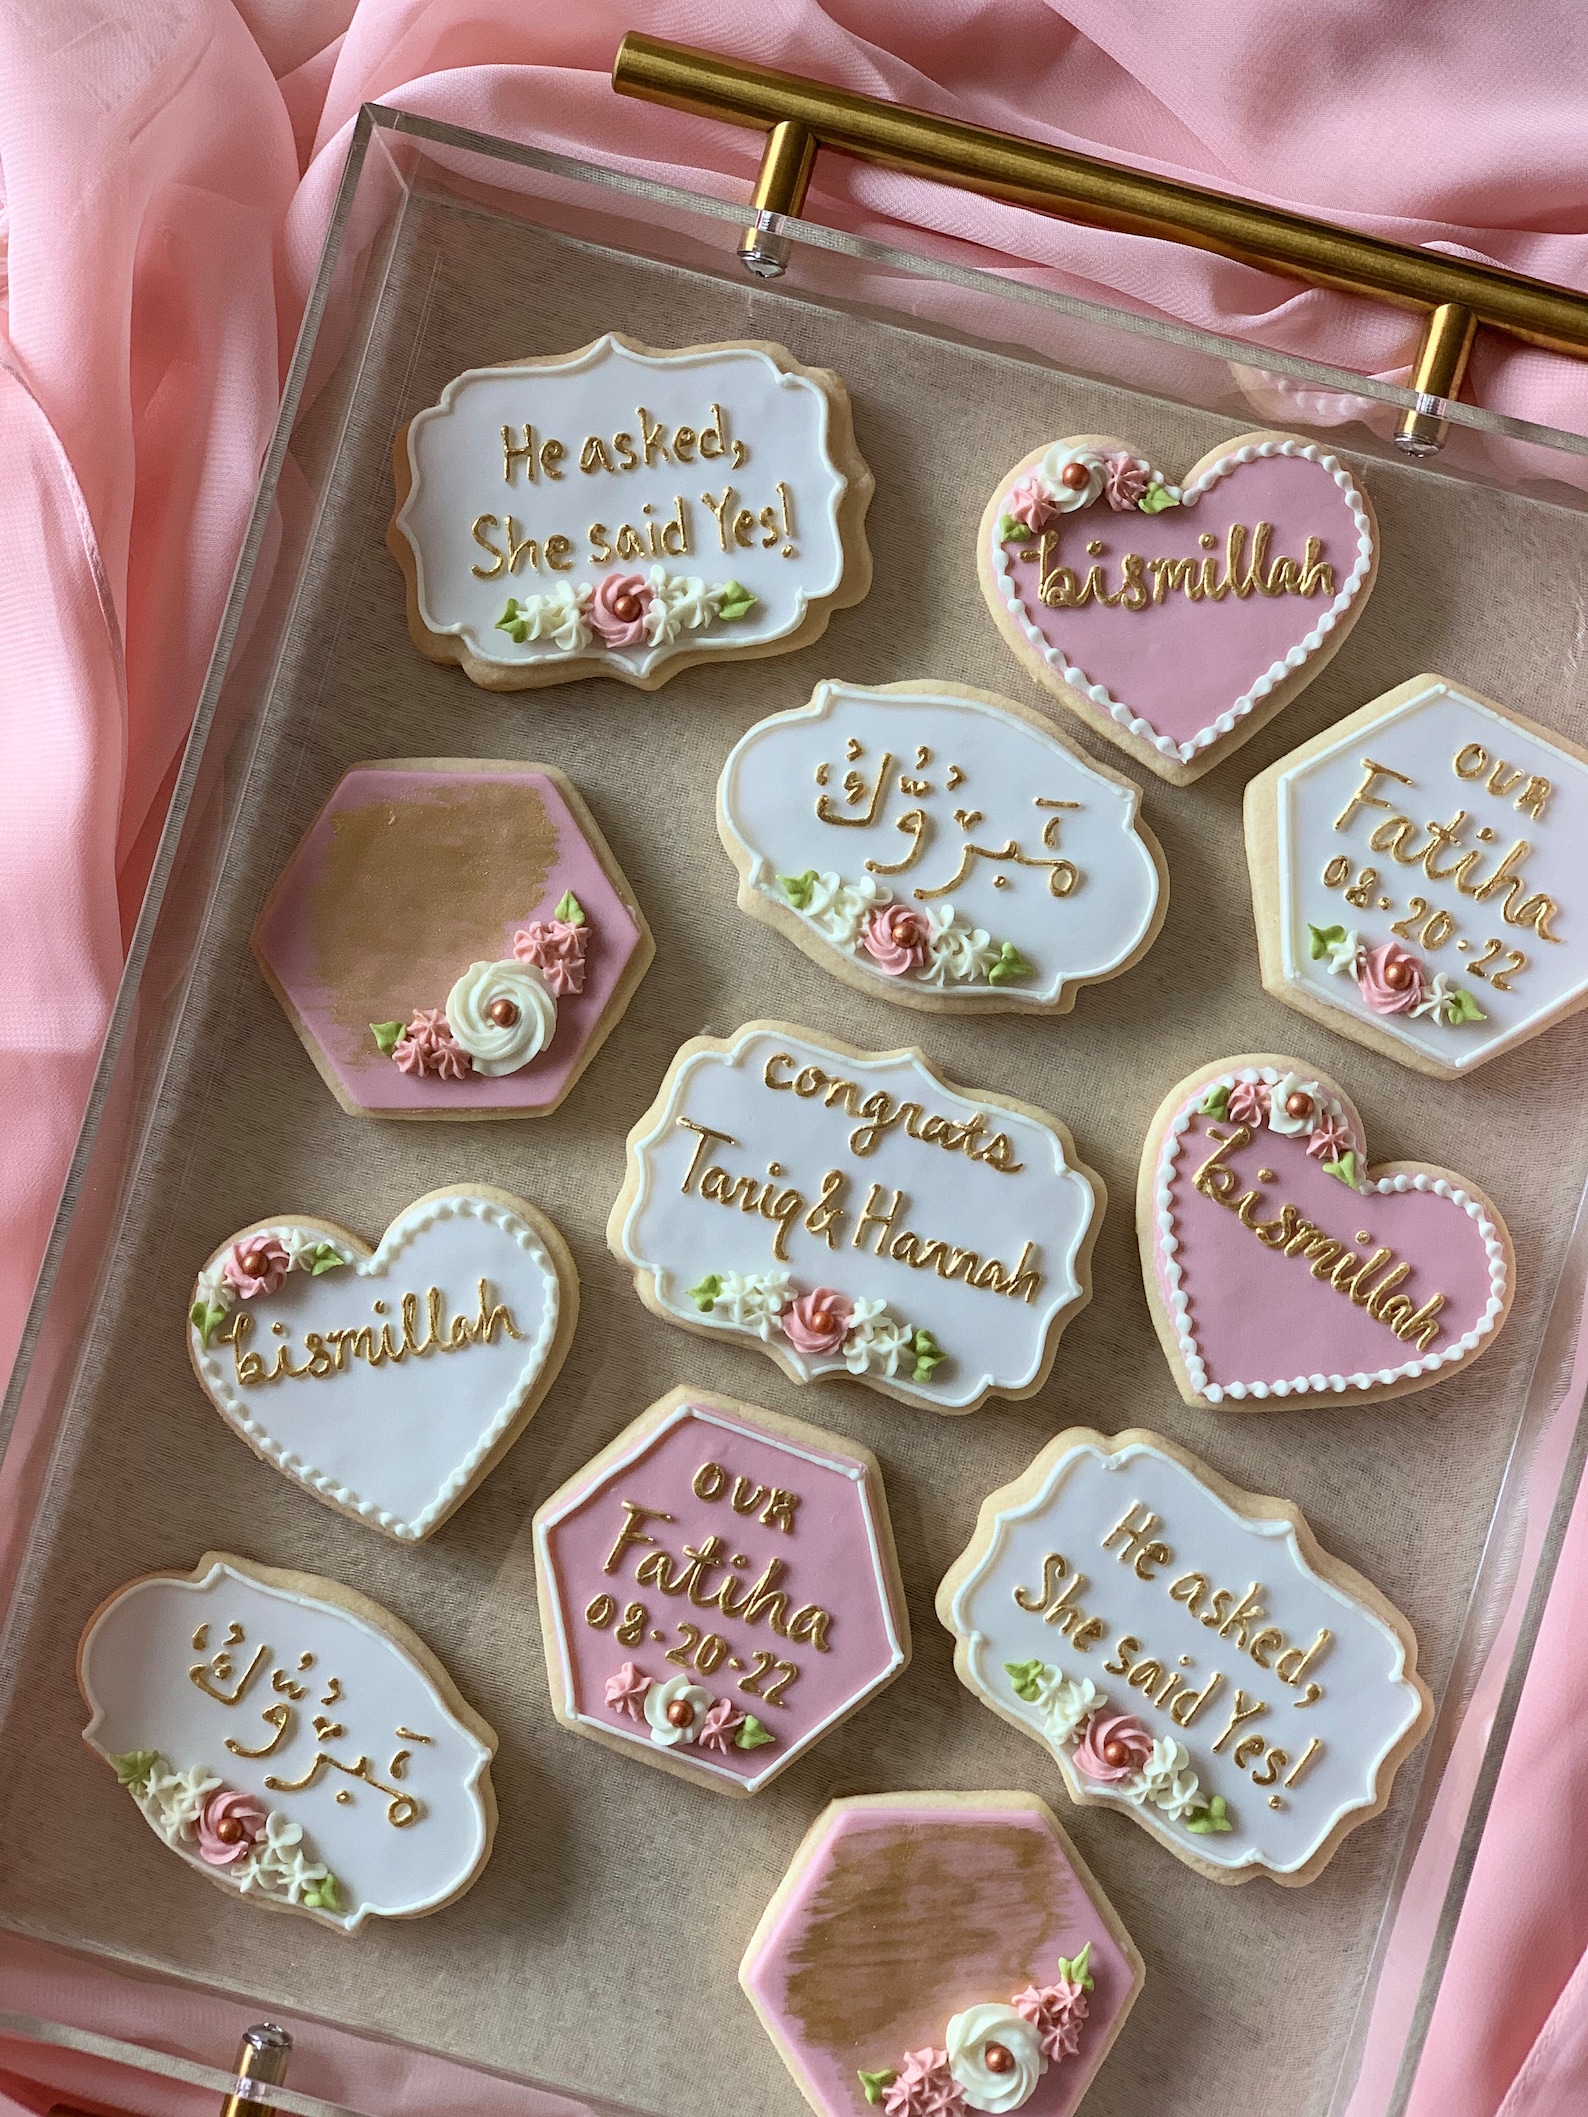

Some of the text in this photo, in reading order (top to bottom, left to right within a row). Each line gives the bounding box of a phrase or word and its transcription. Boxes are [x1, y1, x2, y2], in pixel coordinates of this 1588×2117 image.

[501, 403, 746, 482] He asked,
[470, 481, 794, 581] She said Yes!
[1018, 521, 1336, 611] bismillah
[1333, 757, 1563, 943] Fatiha
[762, 1052, 1024, 1173] congrats
[676, 1116, 1042, 1304] Tariq & Hannah
[1192, 1126, 1445, 1351] bismillah
[217, 1278, 525, 1385] bismillah
[603, 1500, 829, 1652] Fatiha
[1101, 1500, 1334, 1708] He asked,
[1013, 1552, 1323, 1809] She said Yes!
